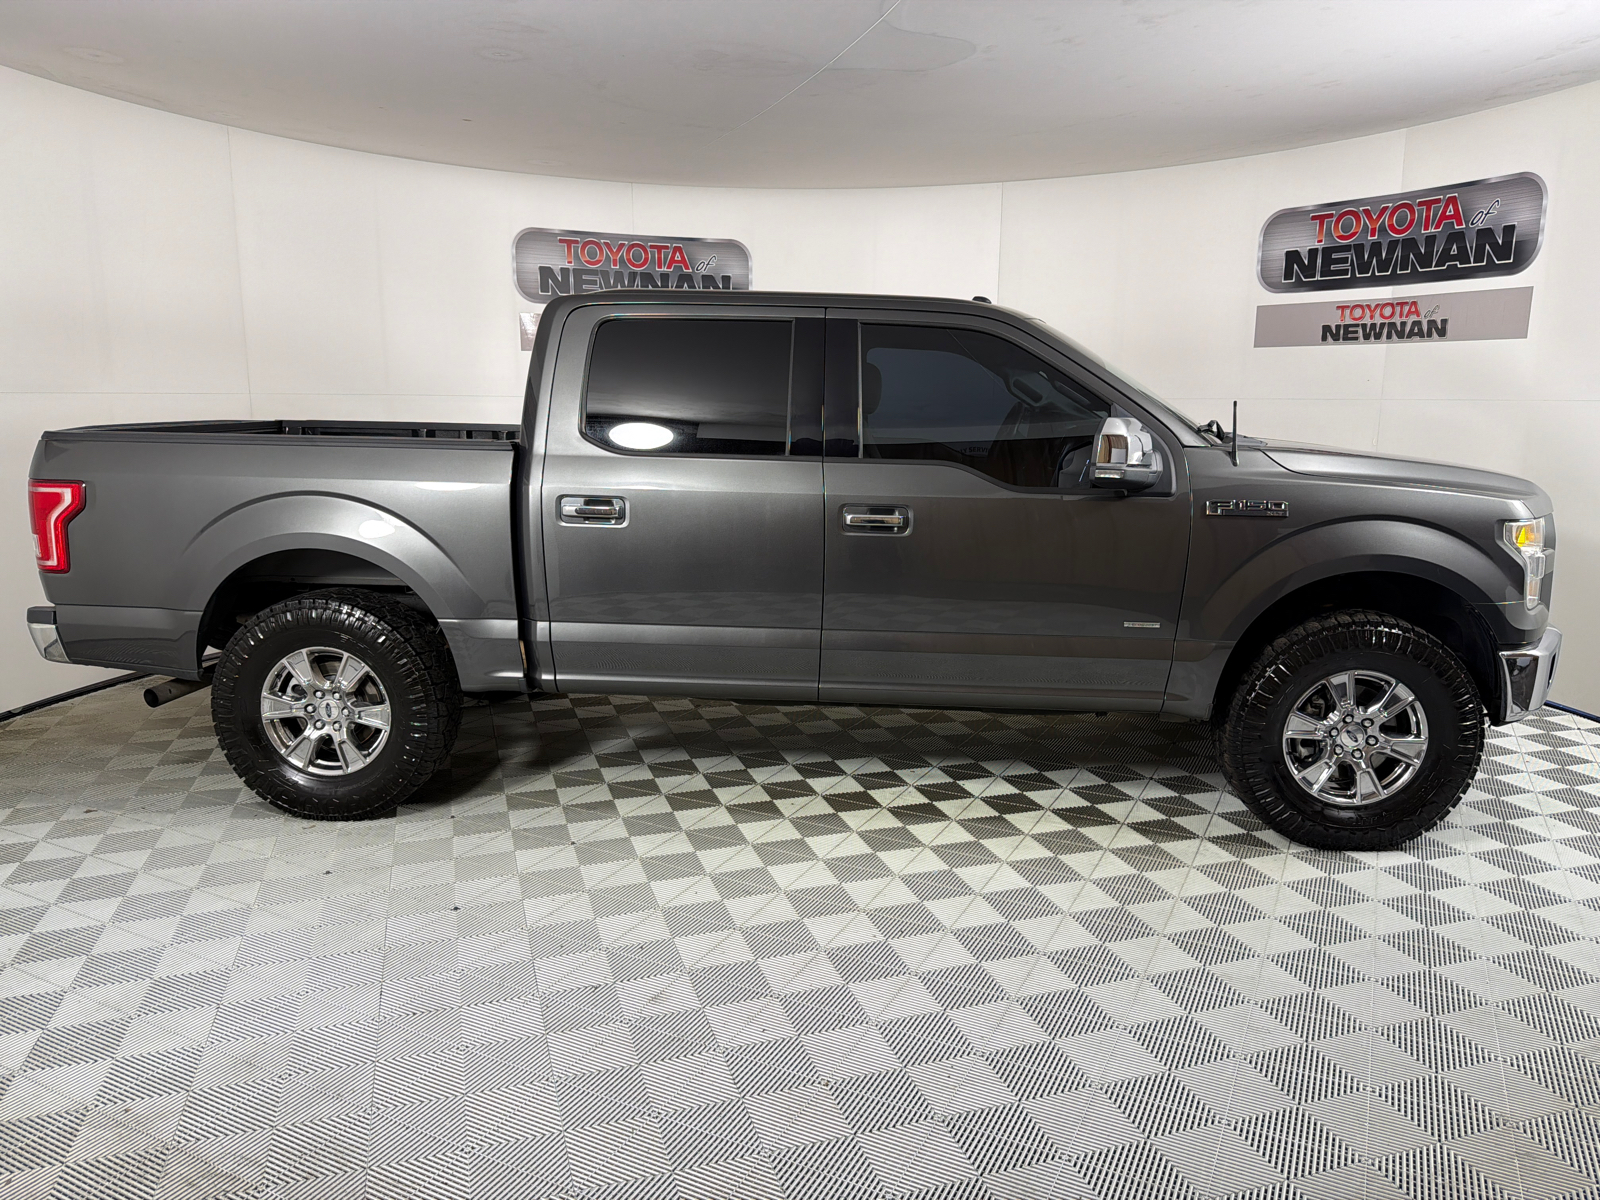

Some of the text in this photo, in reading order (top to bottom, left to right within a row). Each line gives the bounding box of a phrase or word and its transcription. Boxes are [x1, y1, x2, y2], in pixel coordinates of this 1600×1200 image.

[1310, 193, 1499, 245] TOYOTA of
[557, 236, 717, 273] TOYOTA of
[1281, 223, 1517, 283] NEWNAN
[1336, 300, 1440, 323] TOYOTA of
[1320, 318, 1448, 343] NEWNAN
